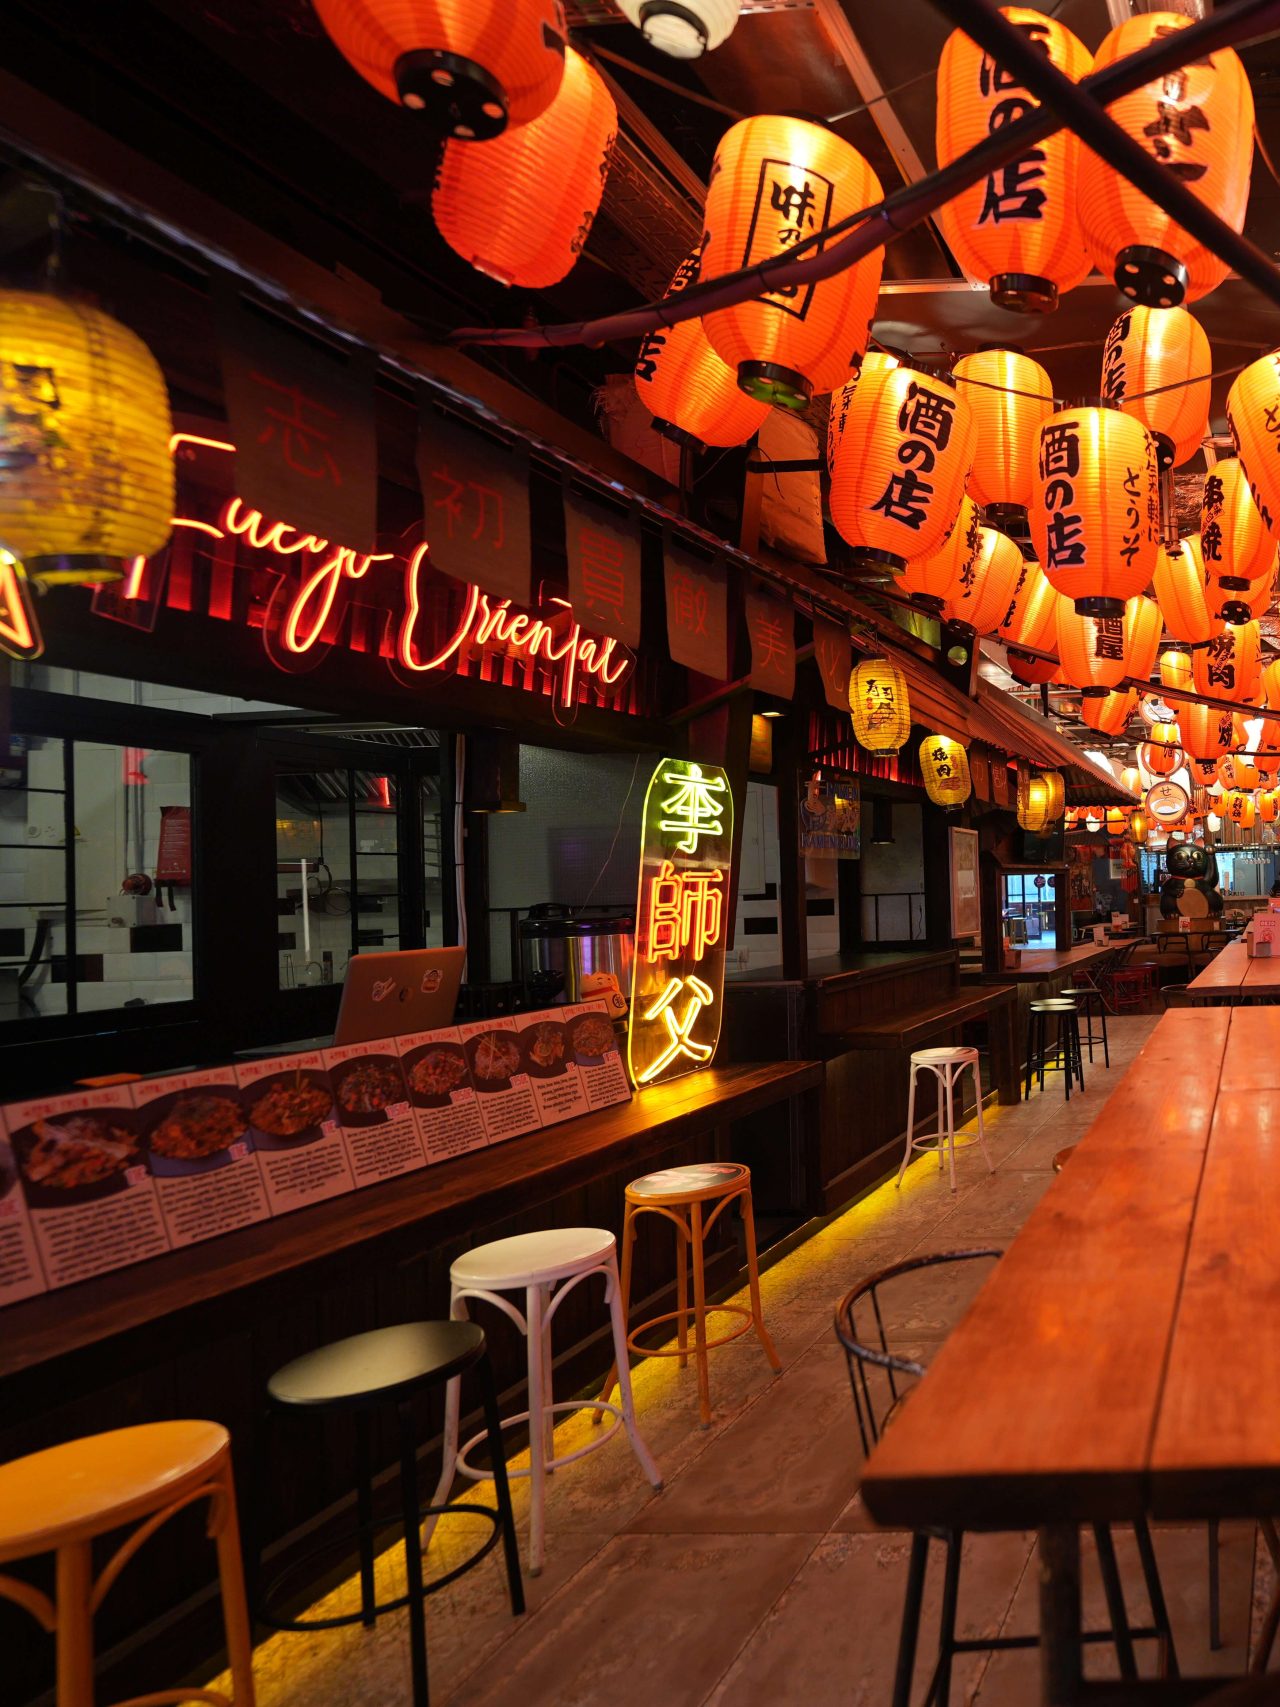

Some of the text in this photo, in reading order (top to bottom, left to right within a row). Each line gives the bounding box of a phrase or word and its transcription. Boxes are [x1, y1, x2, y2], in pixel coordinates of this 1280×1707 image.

[869, 380, 956, 531] 酒の店
[1039, 421, 1087, 570] 酒の店
[1119, 465, 1144, 567] どうぞ
[638, 764, 728, 1083] 李師父
